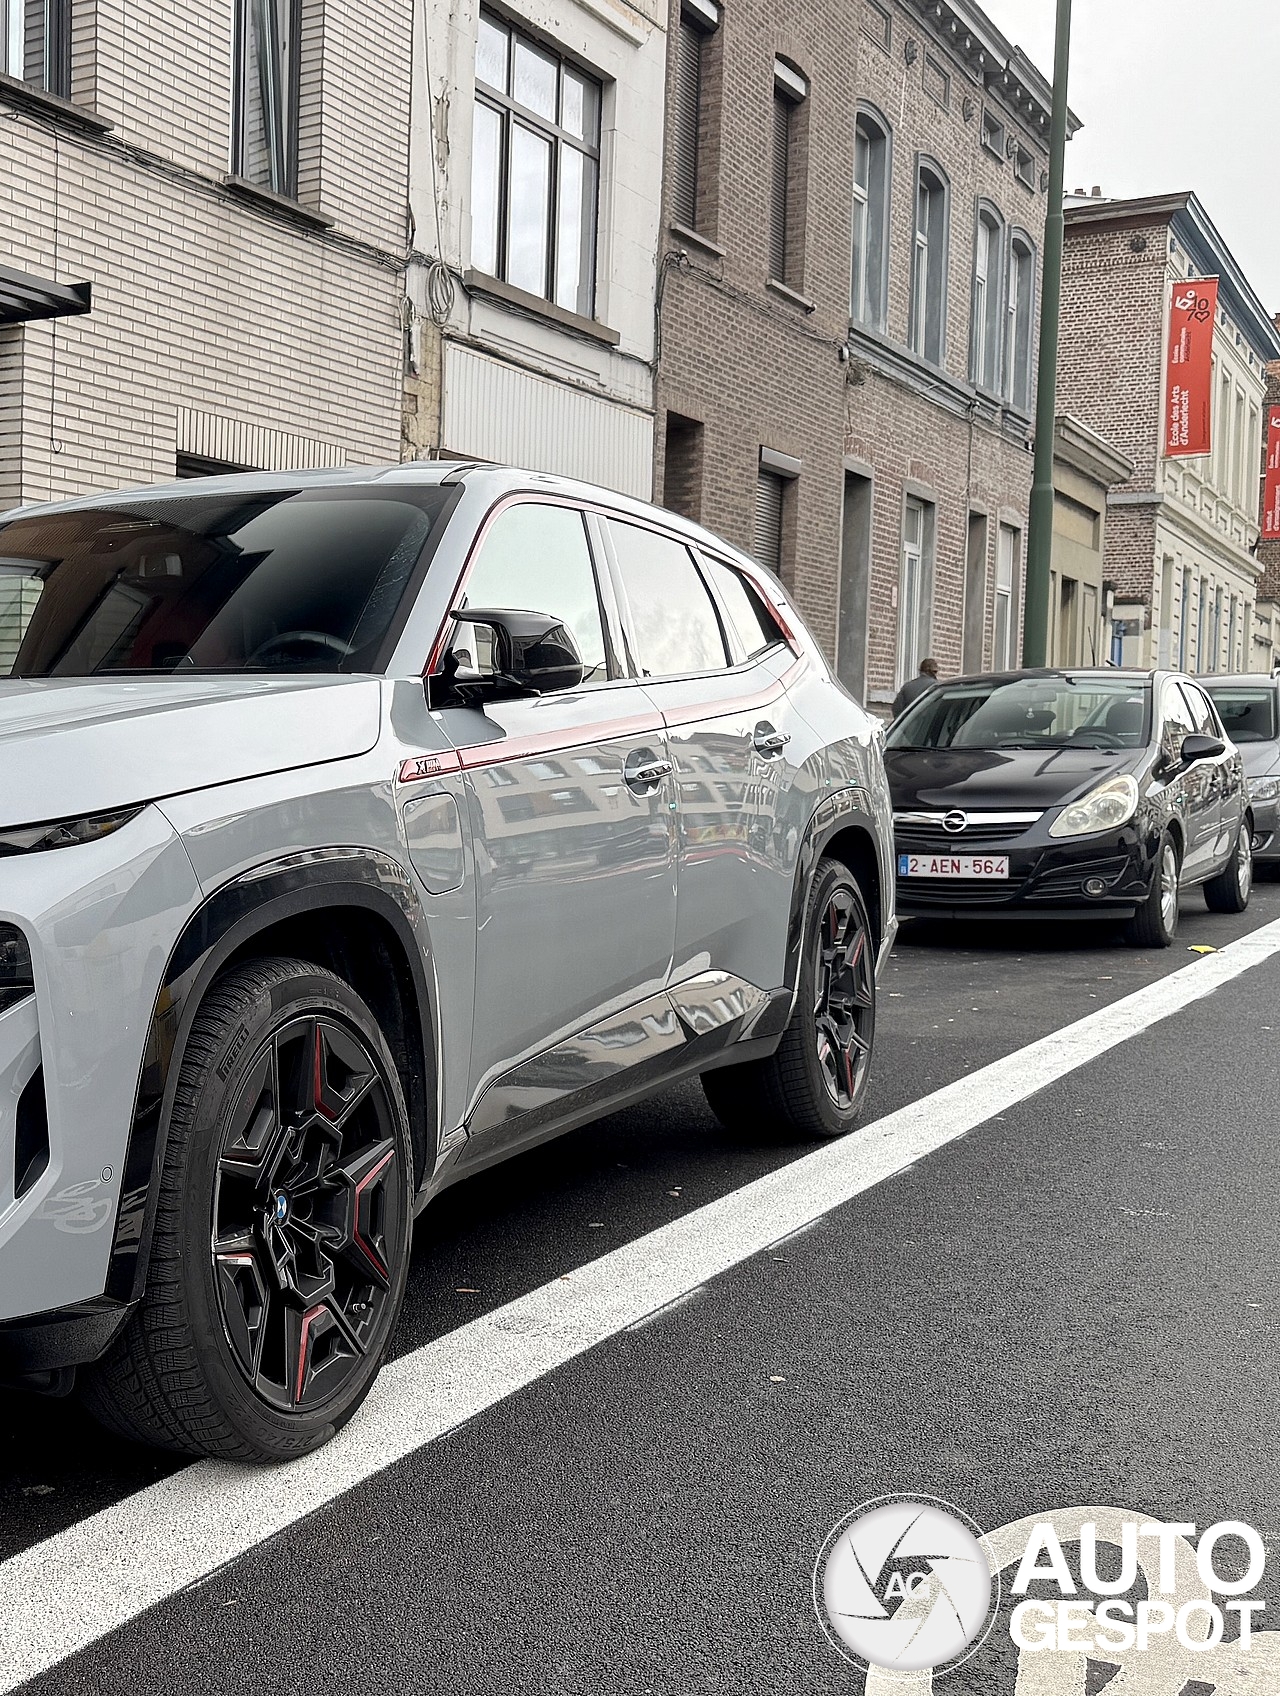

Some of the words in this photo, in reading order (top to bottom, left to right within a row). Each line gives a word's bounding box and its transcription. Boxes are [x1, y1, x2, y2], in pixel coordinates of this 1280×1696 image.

[1170, 385, 1180, 404] Arts
[1170, 404, 1179, 421] des
[1168, 421, 1179, 447] École
[909, 858, 1005, 875] 2-AEN-564
